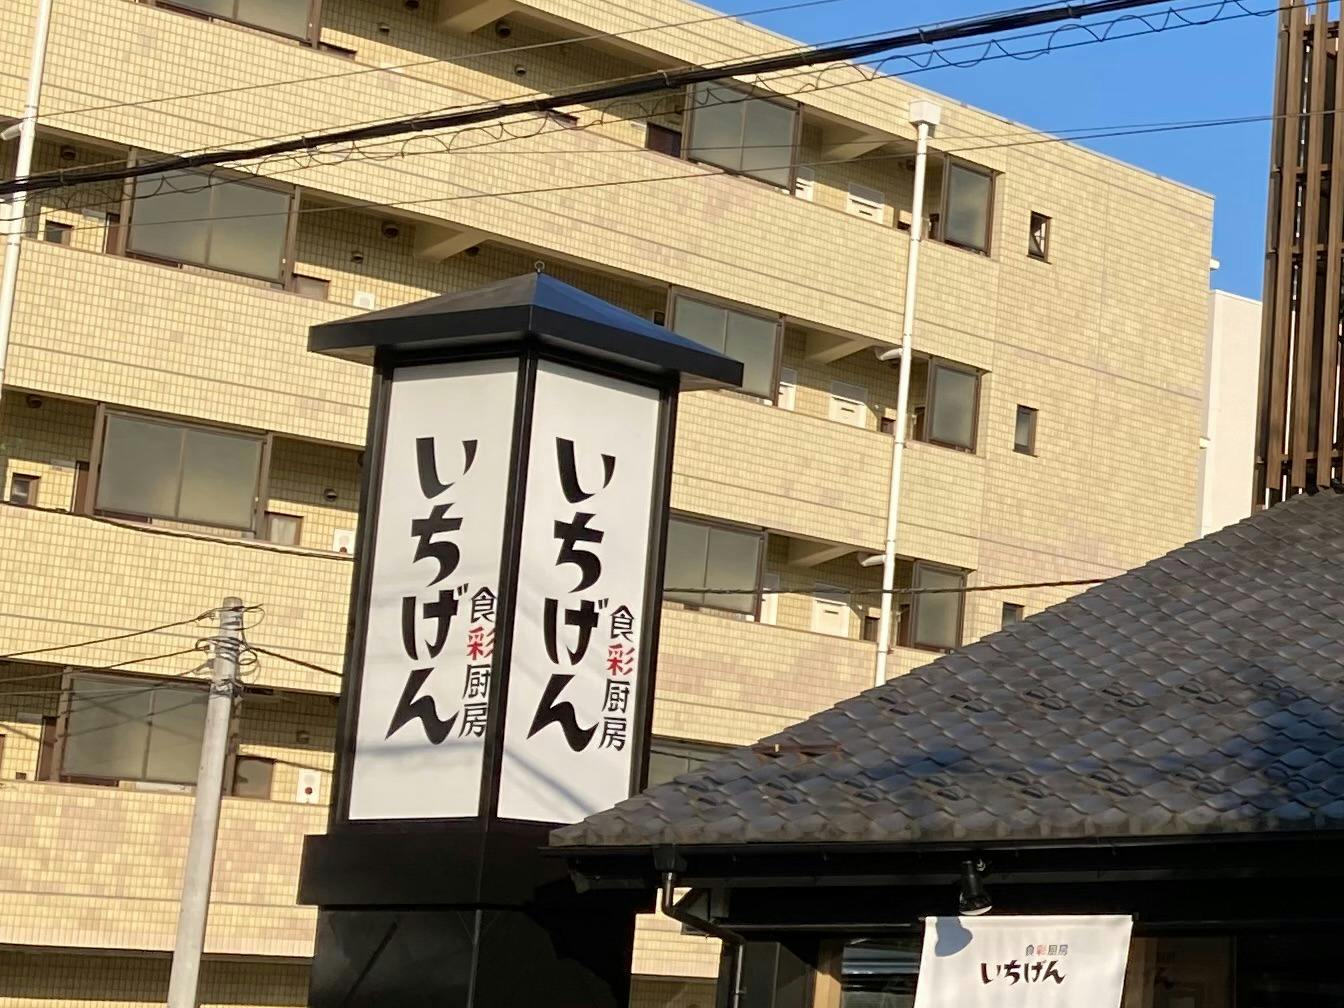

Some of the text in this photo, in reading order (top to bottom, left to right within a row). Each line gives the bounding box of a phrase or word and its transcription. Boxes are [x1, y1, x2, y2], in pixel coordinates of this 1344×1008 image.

[385, 436, 479, 745] いちげん
[458, 586, 497, 738] 食彩厨房
[527, 436, 616, 752] いちげん
[599, 604, 636, 752] 食彩厨房
[980, 960, 1066, 986] いちげん
